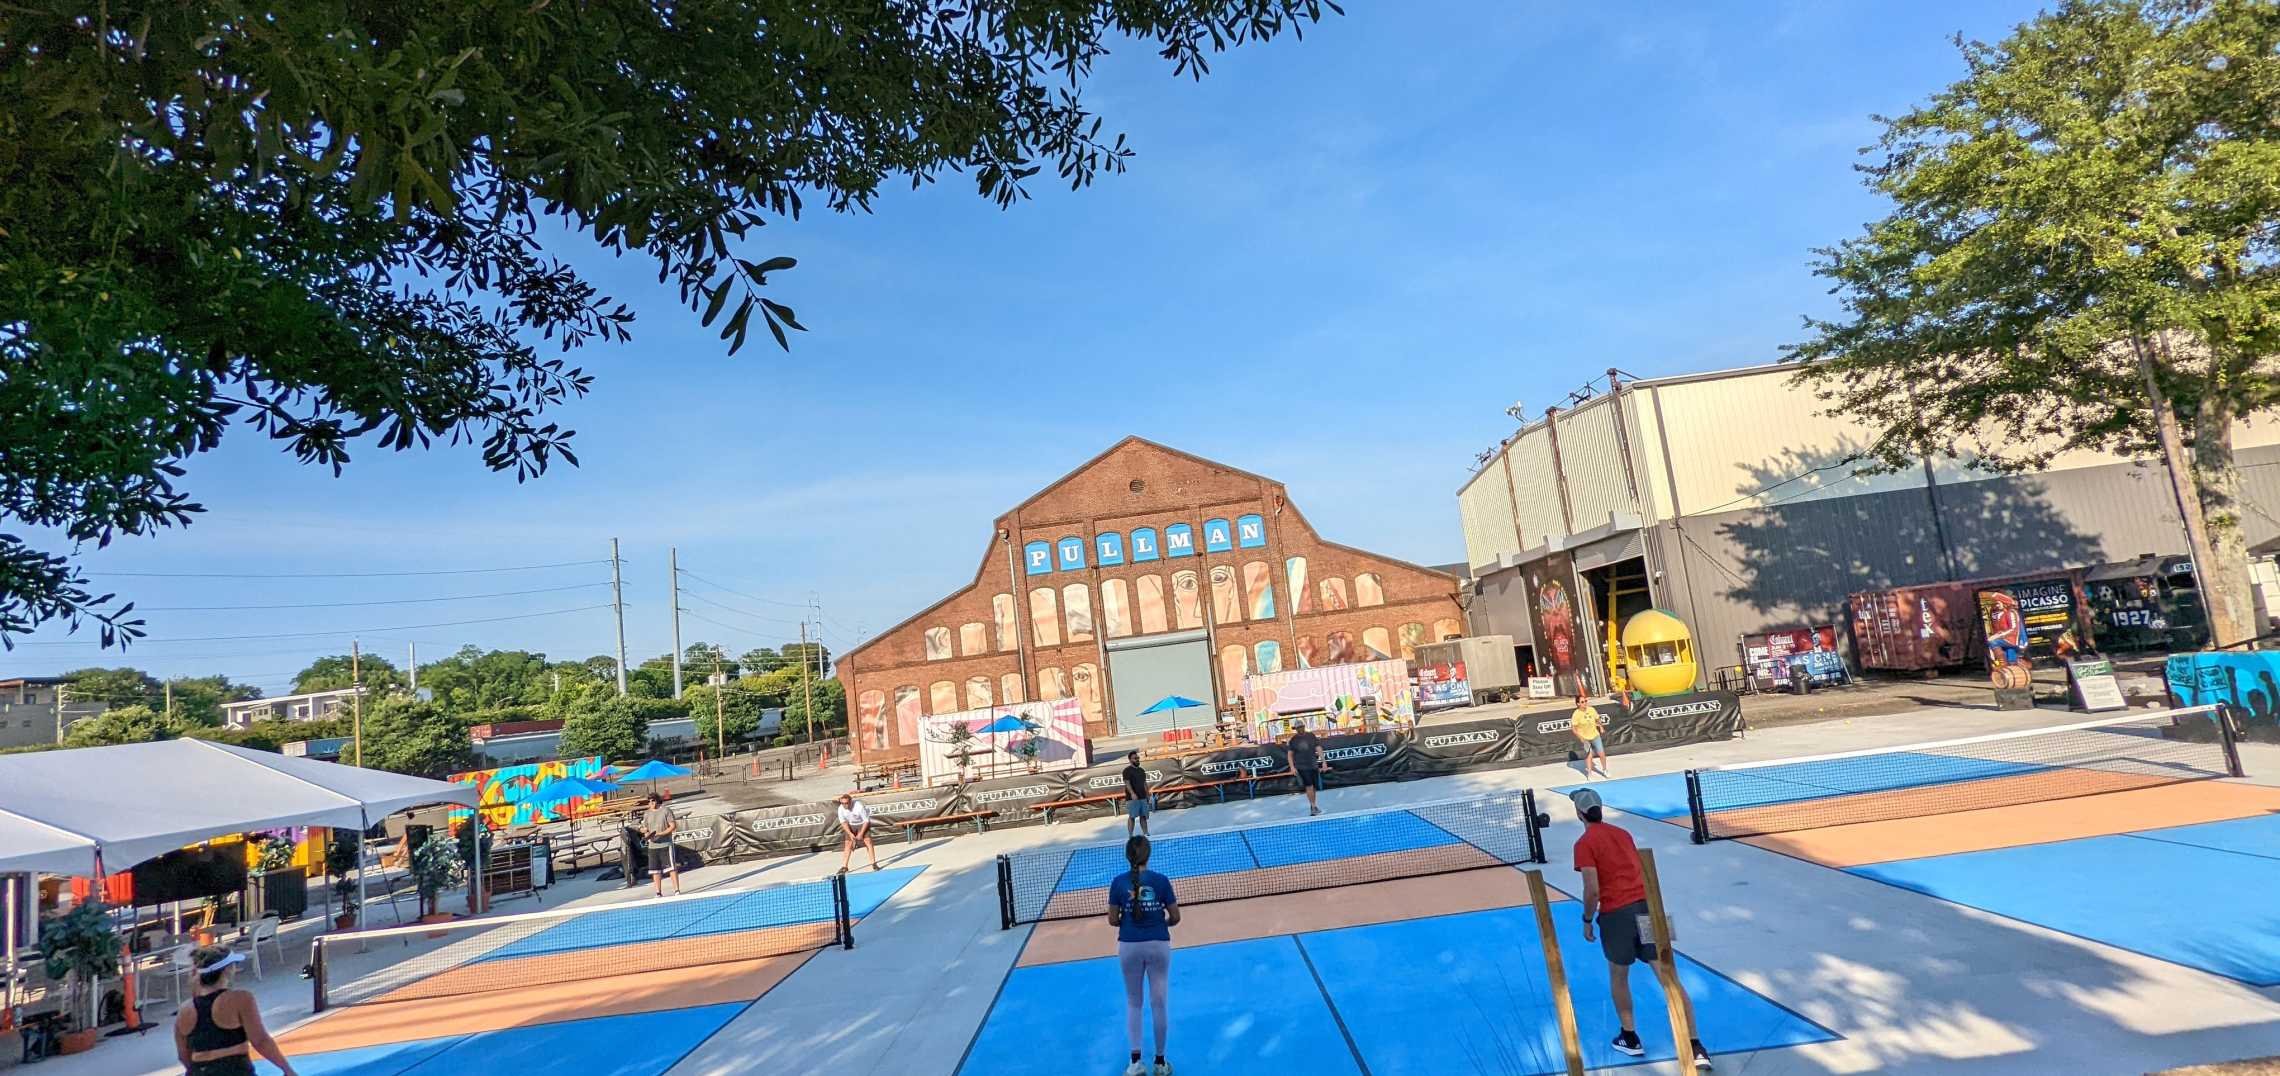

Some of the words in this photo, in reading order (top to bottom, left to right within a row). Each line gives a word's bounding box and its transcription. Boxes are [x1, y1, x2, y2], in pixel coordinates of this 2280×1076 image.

[1031, 523, 1259, 567] PULLMAN
[2018, 585, 2066, 599] IMAGINE
[2020, 595, 2069, 609] PICASSO
[2112, 610, 2150, 627] 1927
[1652, 702, 1717, 718] PULLMAN
[1429, 731, 1495, 747] PULLMAN
[1206, 757, 1269, 773] PULLMAN
[1093, 772, 1159, 787] PULLN
[981, 787, 1044, 801] PULLMAN
[869, 800, 934, 816] PULLMAN
[757, 815, 822, 830] PULLMAN
